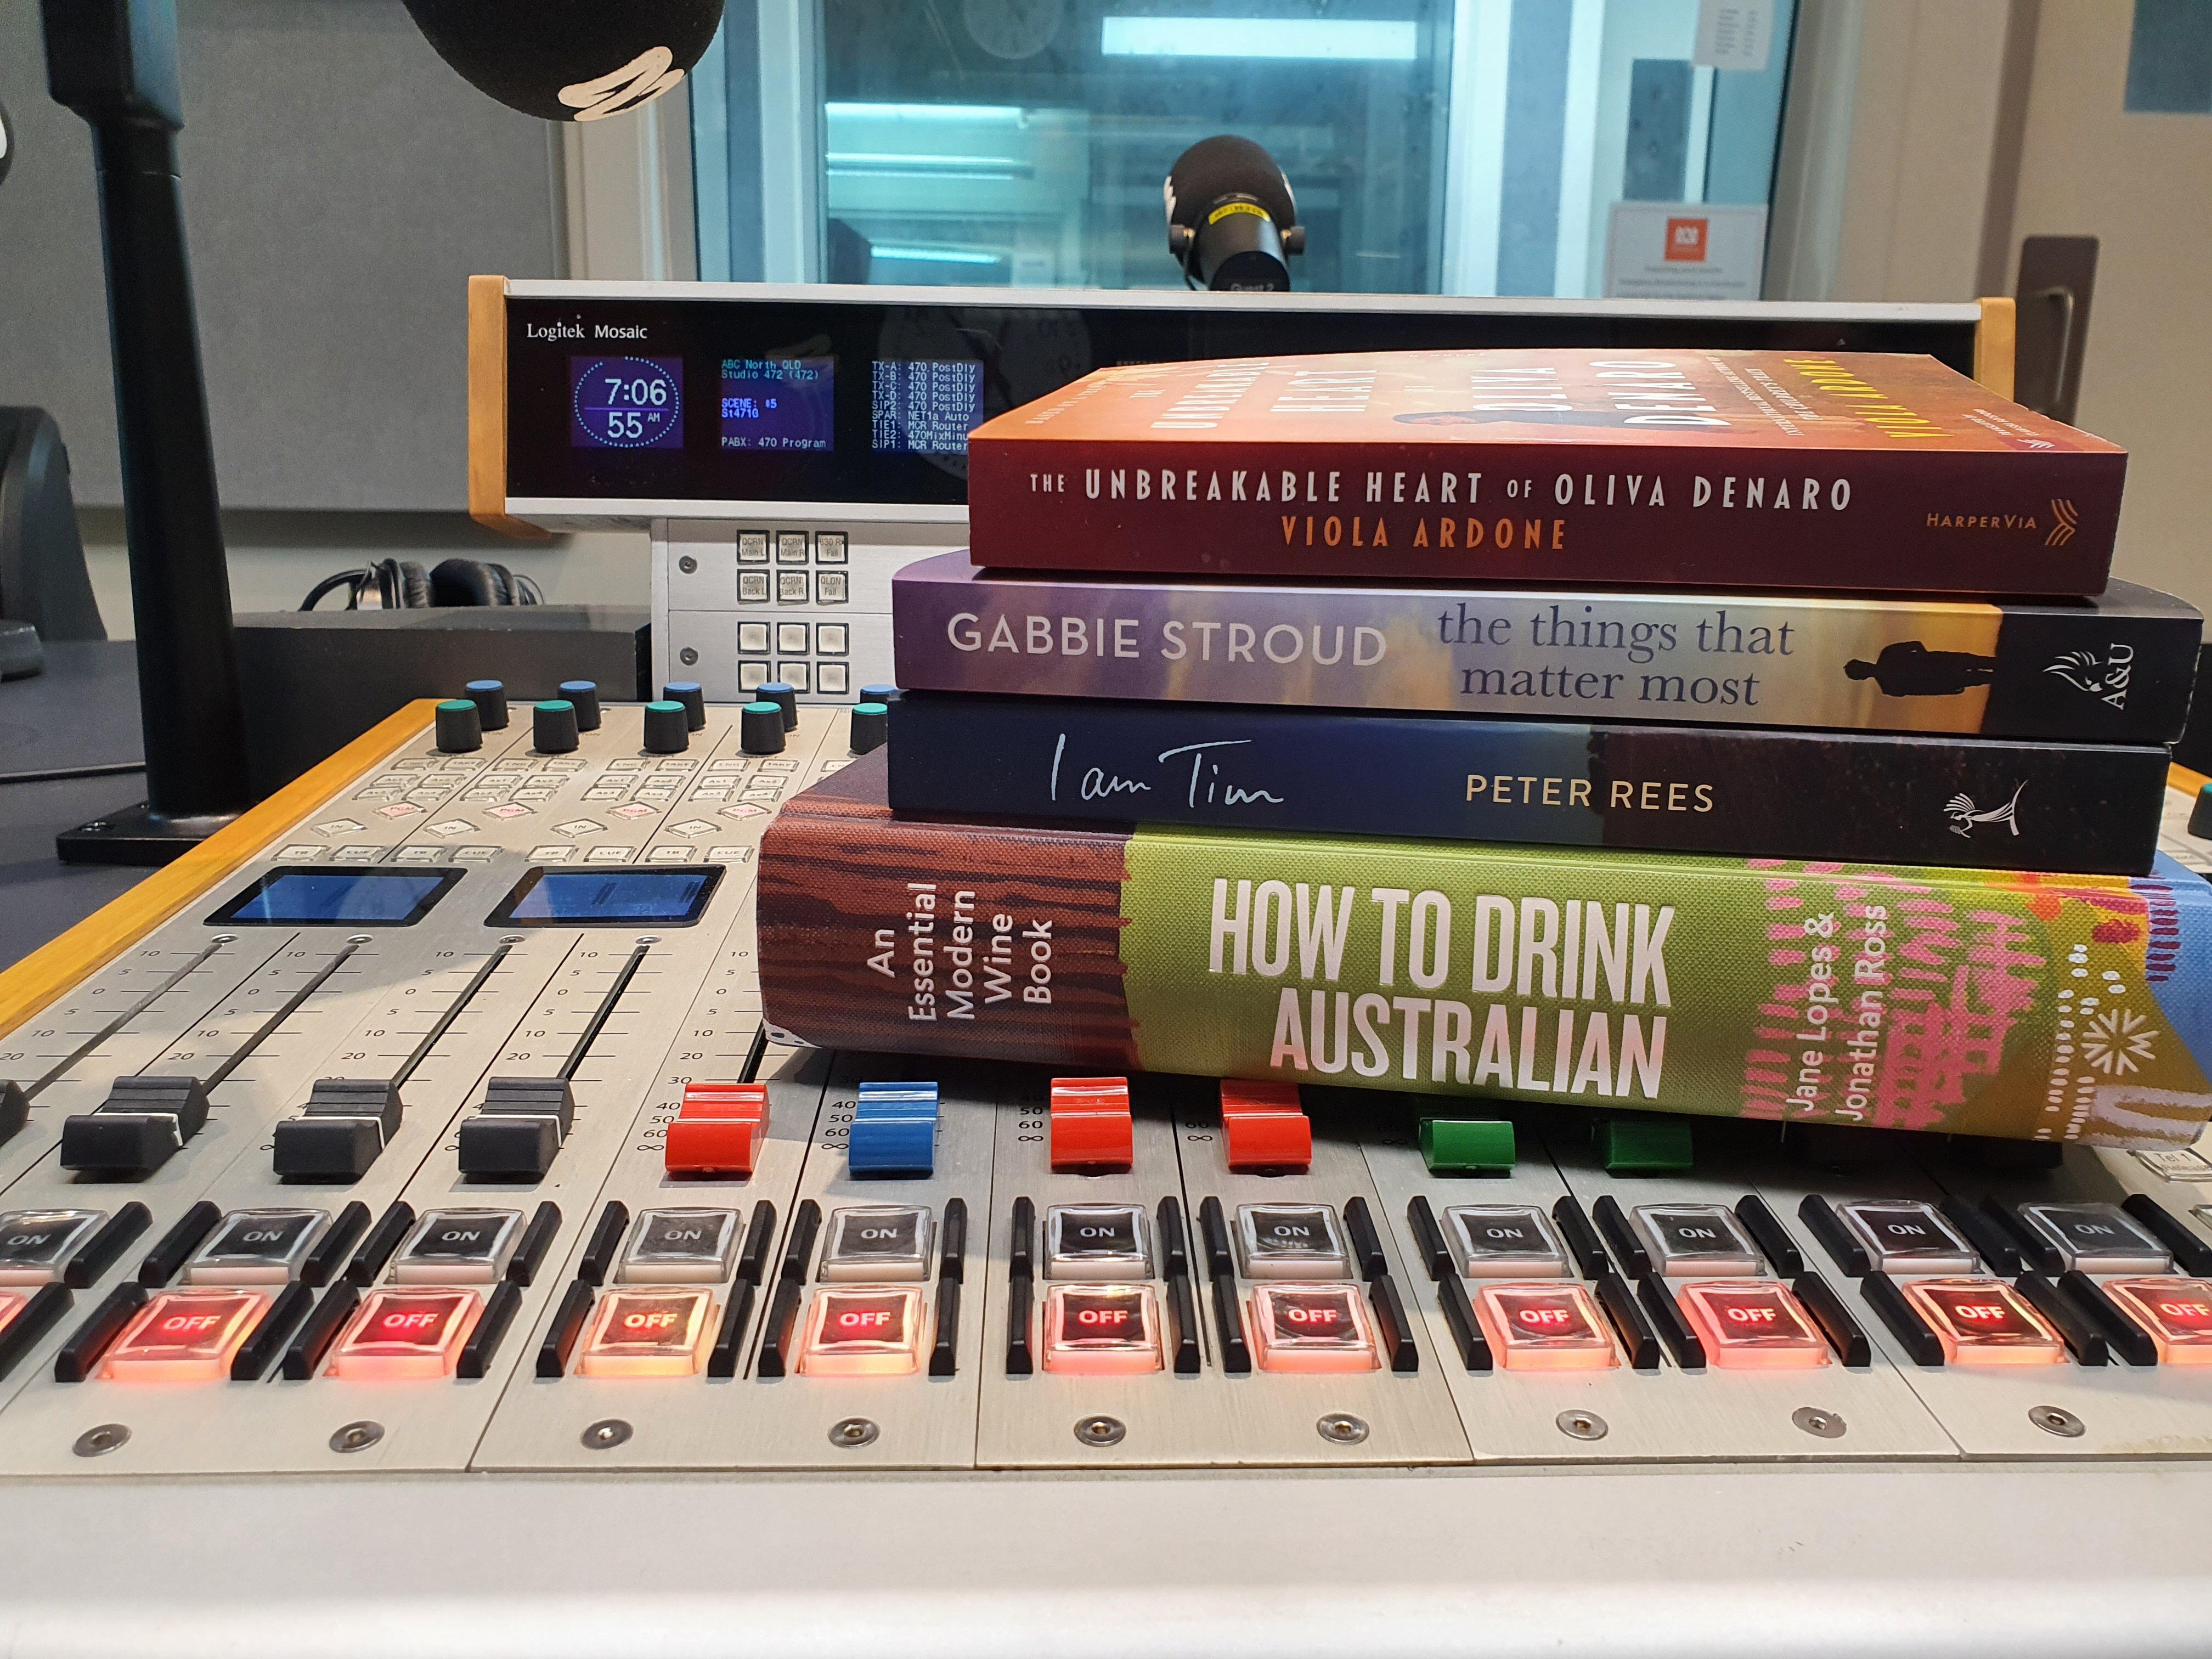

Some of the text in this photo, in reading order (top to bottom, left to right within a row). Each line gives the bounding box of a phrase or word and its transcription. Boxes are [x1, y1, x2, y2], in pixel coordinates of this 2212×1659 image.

[527, 322, 648, 341] Logitek Mosaic
[721, 359, 802, 370] ABC North QLD
[872, 361, 975, 374] TX-A: 470 PostDly
[721, 370, 819, 380] Studio 472 (472)
[872, 371, 975, 383] TX-B: 470 PostDly
[1784, 359, 1889, 399] ARDONE
[605, 379, 667, 405] 7:06
[872, 381, 975, 393] TX-C: 470 PostDly
[1150, 362, 1270, 428] UNBREAKABLE
[1270, 370, 1377, 411] HEART
[1471, 368, 1574, 411] OLIVA
[1589, 360, 1732, 426] DENARO
[721, 398, 757, 408] SCENE:
[872, 391, 975, 403] TX-D: 470 PostDly
[872, 400, 975, 413] SIP2: 470 PostDly
[872, 410, 969, 421] SPAR: NET1a Auto
[1846, 405, 1955, 437] VIOLA
[607, 412, 660, 438] 55 AM
[872, 420, 968, 431] TIE1: MCR Router
[872, 430, 901, 439] TIE2:
[721, 437, 826, 449] PABX: 470 Program
[872, 439, 968, 450] SIP1: MCR Router
[1030, 469, 1852, 511] THE UNBREAKABLE HEART OF OLIVA DENARO
[1281, 515, 1565, 549] VIOLA ARDONE
[947, 612, 1387, 667] GABBIE STROUD
[1438, 602, 1796, 664] the things that
[2101, 643, 2134, 710] A&U
[1460, 664, 1760, 706] matter most
[1051, 733, 1284, 808] I am Tim
[1466, 774, 1713, 812] PETER REES
[1209, 877, 1675, 1007] HOW TO DRINK
[867, 929, 895, 978] An
[906, 883, 937, 1022] Essential
[943, 890, 975, 1020] Modern
[983, 913, 1013, 1004] Wine
[1022, 919, 1052, 1004] Book
[1786, 911, 1839, 1111] Jane Lopes &
[1835, 905, 1886, 1121] Jonathan Ross
[1269, 987, 1667, 1099] AUSTRALIAN
[668, 1076, 692, 1085] 30
[656, 1102, 681, 1110] 40
[650, 1116, 674, 1124] 50
[643, 1129, 667, 1138] 60
[242, 1230, 283, 1242] ON
[442, 1230, 480, 1242] ON
[664, 1228, 702, 1241] ON
[860, 1228, 898, 1239] ON
[1080, 1227, 1115, 1238] ON
[1273, 1226, 1309, 1238] ON
[1486, 1227, 1523, 1239] ON
[1678, 1227, 1715, 1239] ON
[1887, 1224, 1925, 1236] ON
[2075, 1224, 2114, 1236] ON
[7, 1234, 50, 1245] ON
[1077, 1309, 1127, 1325] OFF
[1287, 1307, 1336, 1323] OFF
[1519, 1308, 1568, 1324] OFF
[1726, 1306, 1776, 1322] OFF
[1955, 1304, 2006, 1320] OFF
[2160, 1304, 2209, 1318] OFF
[162, 1314, 219, 1330] OFF
[383, 1313, 438, 1329] OFF
[623, 1313, 678, 1328] OFF
[839, 1312, 891, 1328] OFF
